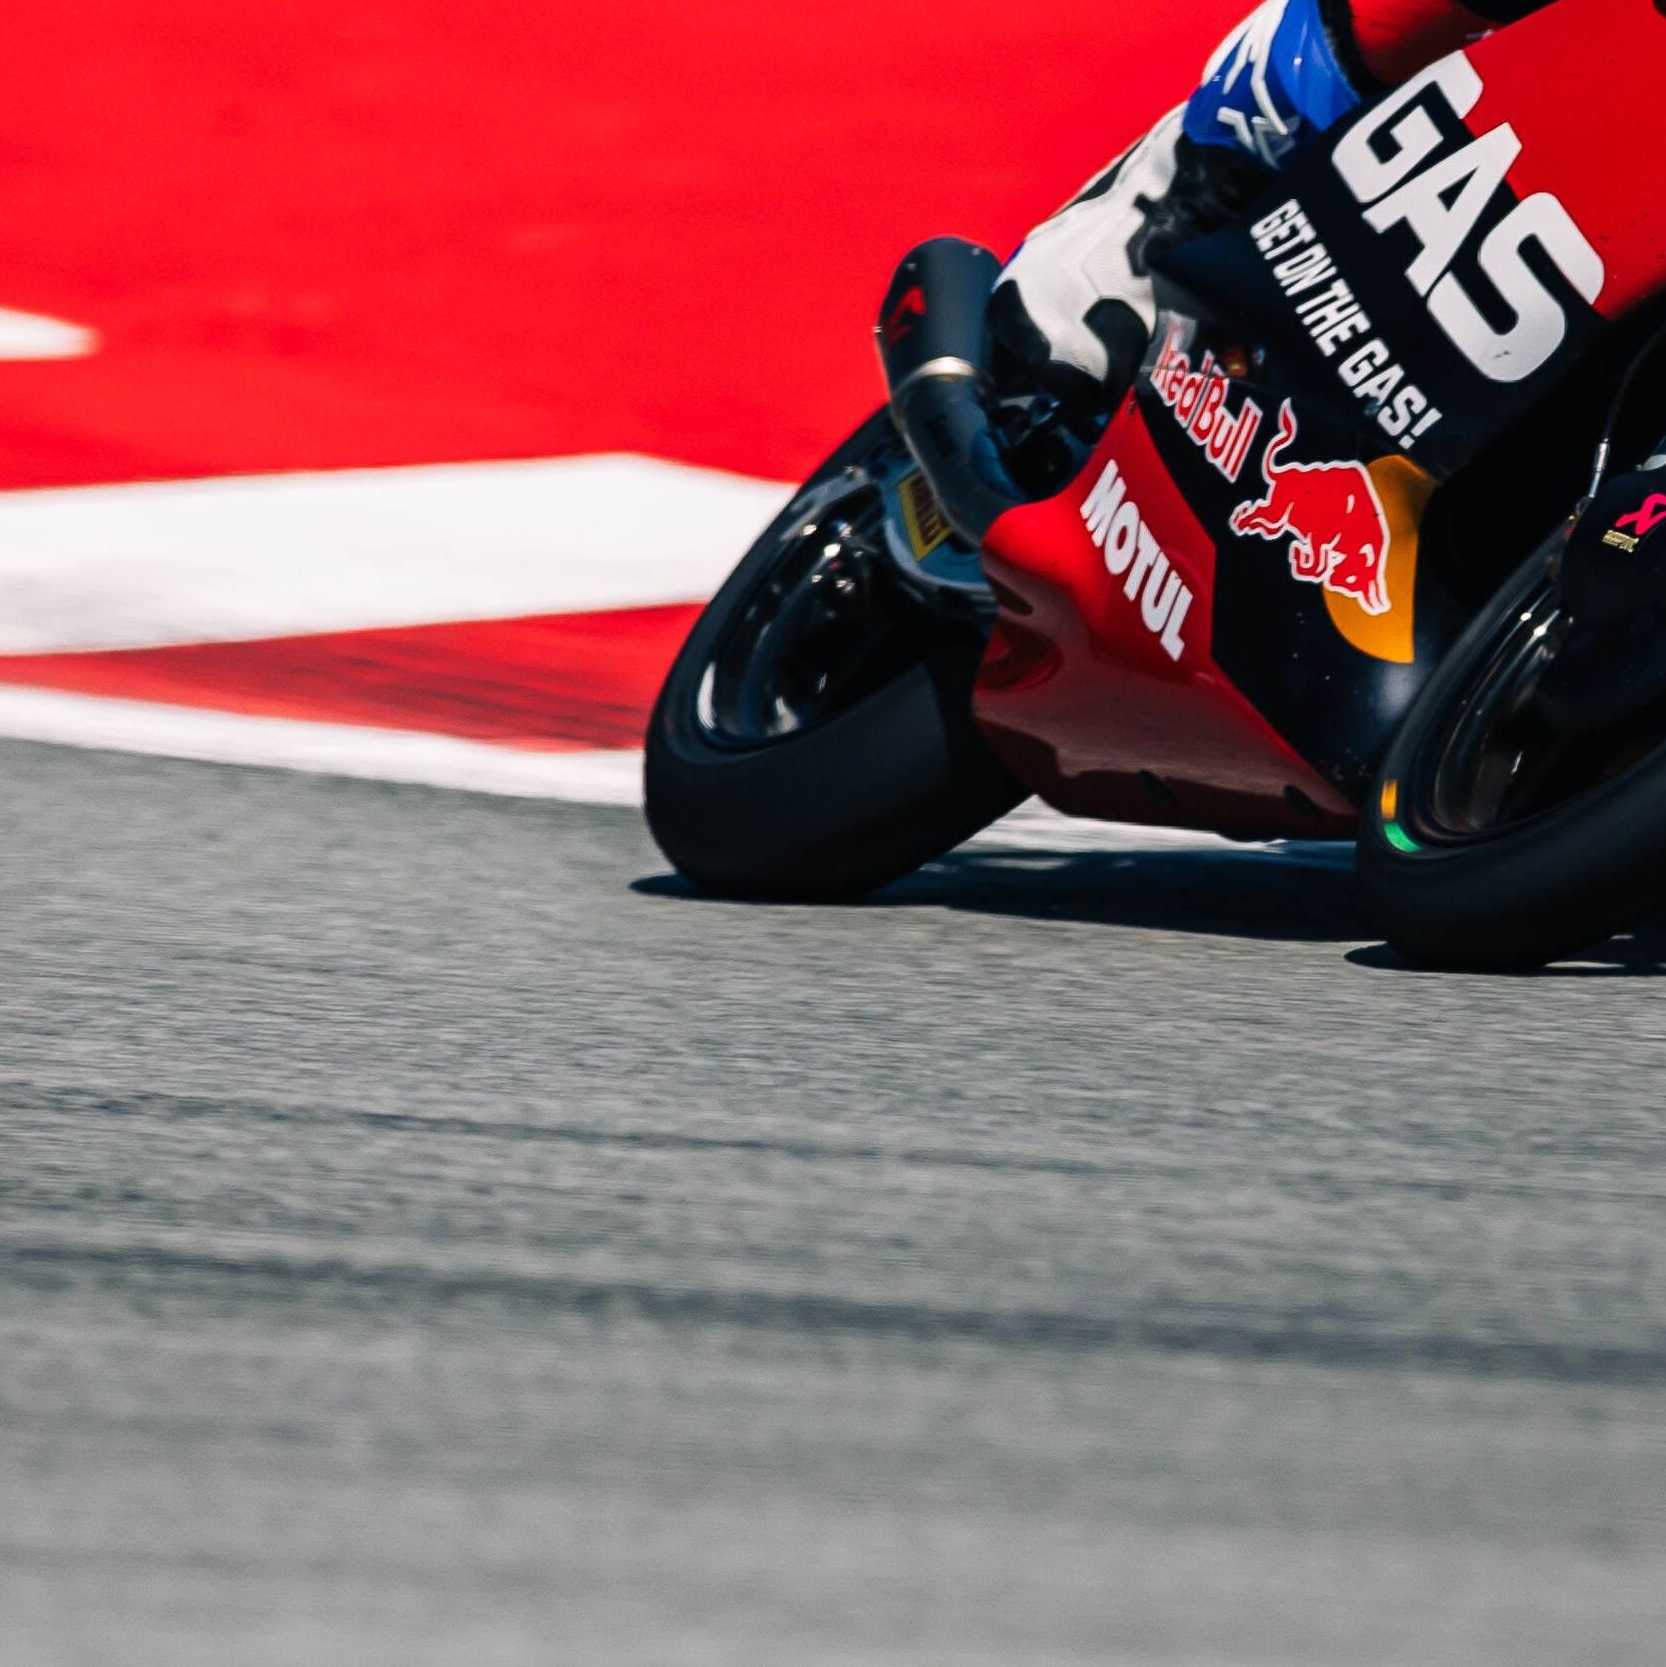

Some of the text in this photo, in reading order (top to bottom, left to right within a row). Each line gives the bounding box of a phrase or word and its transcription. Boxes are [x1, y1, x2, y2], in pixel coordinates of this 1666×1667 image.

[1250, 198, 1442, 450] GET ON THE GAS!
[1333, 50, 1605, 382] GAS
[1186, 364, 1263, 483] Bull
[1079, 458, 1193, 661] MOTUL
